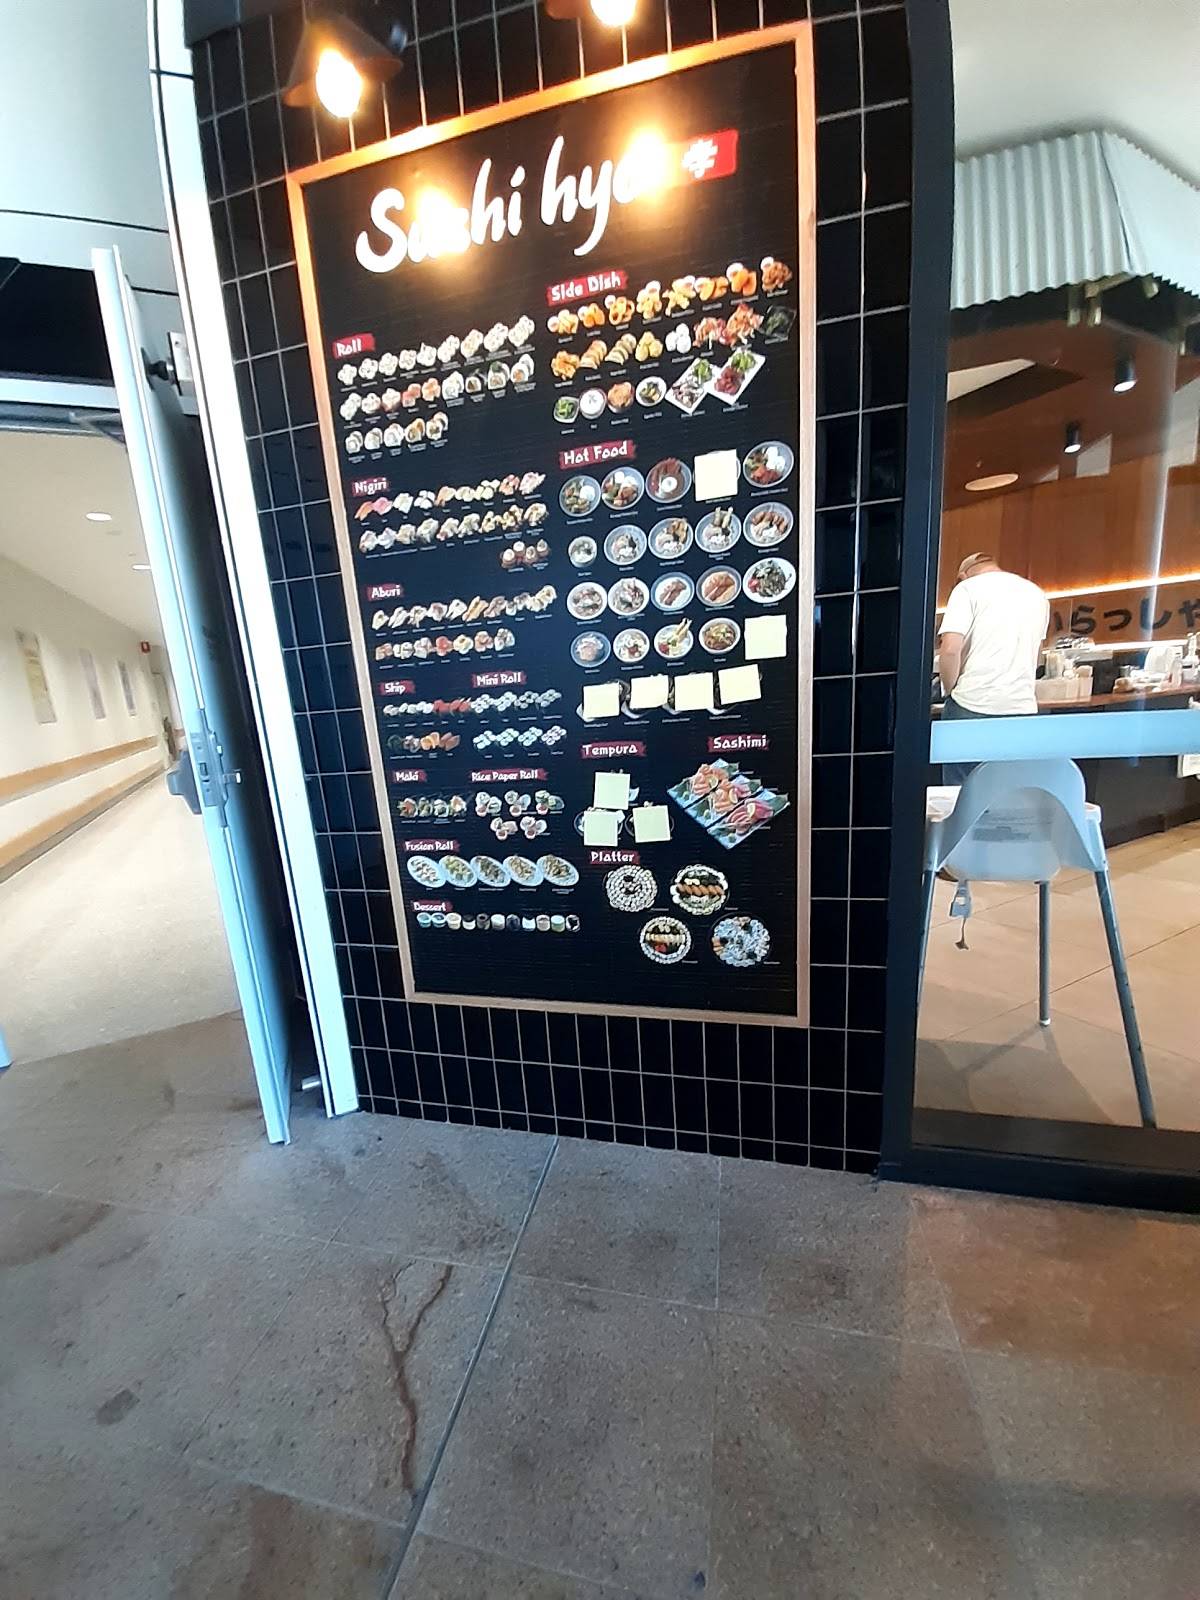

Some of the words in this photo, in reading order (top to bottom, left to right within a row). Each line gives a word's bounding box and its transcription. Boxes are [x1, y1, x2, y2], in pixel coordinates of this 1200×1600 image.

[588, 272, 622, 293] Dish
[336, 339, 362, 356] Roll
[564, 449, 590, 466] Hot
[594, 441, 628, 460] Food
[355, 477, 387, 495] Nigiri
[371, 584, 401, 599] Aburi
[476, 675, 499, 686] Mini
[500, 672, 522, 684] Roll
[385, 681, 406, 695] Ship
[713, 735, 767, 750] Sashimi
[583, 744, 638, 758] Tempura
[519, 769, 538, 780] Roll
[591, 851, 635, 863] Platter
